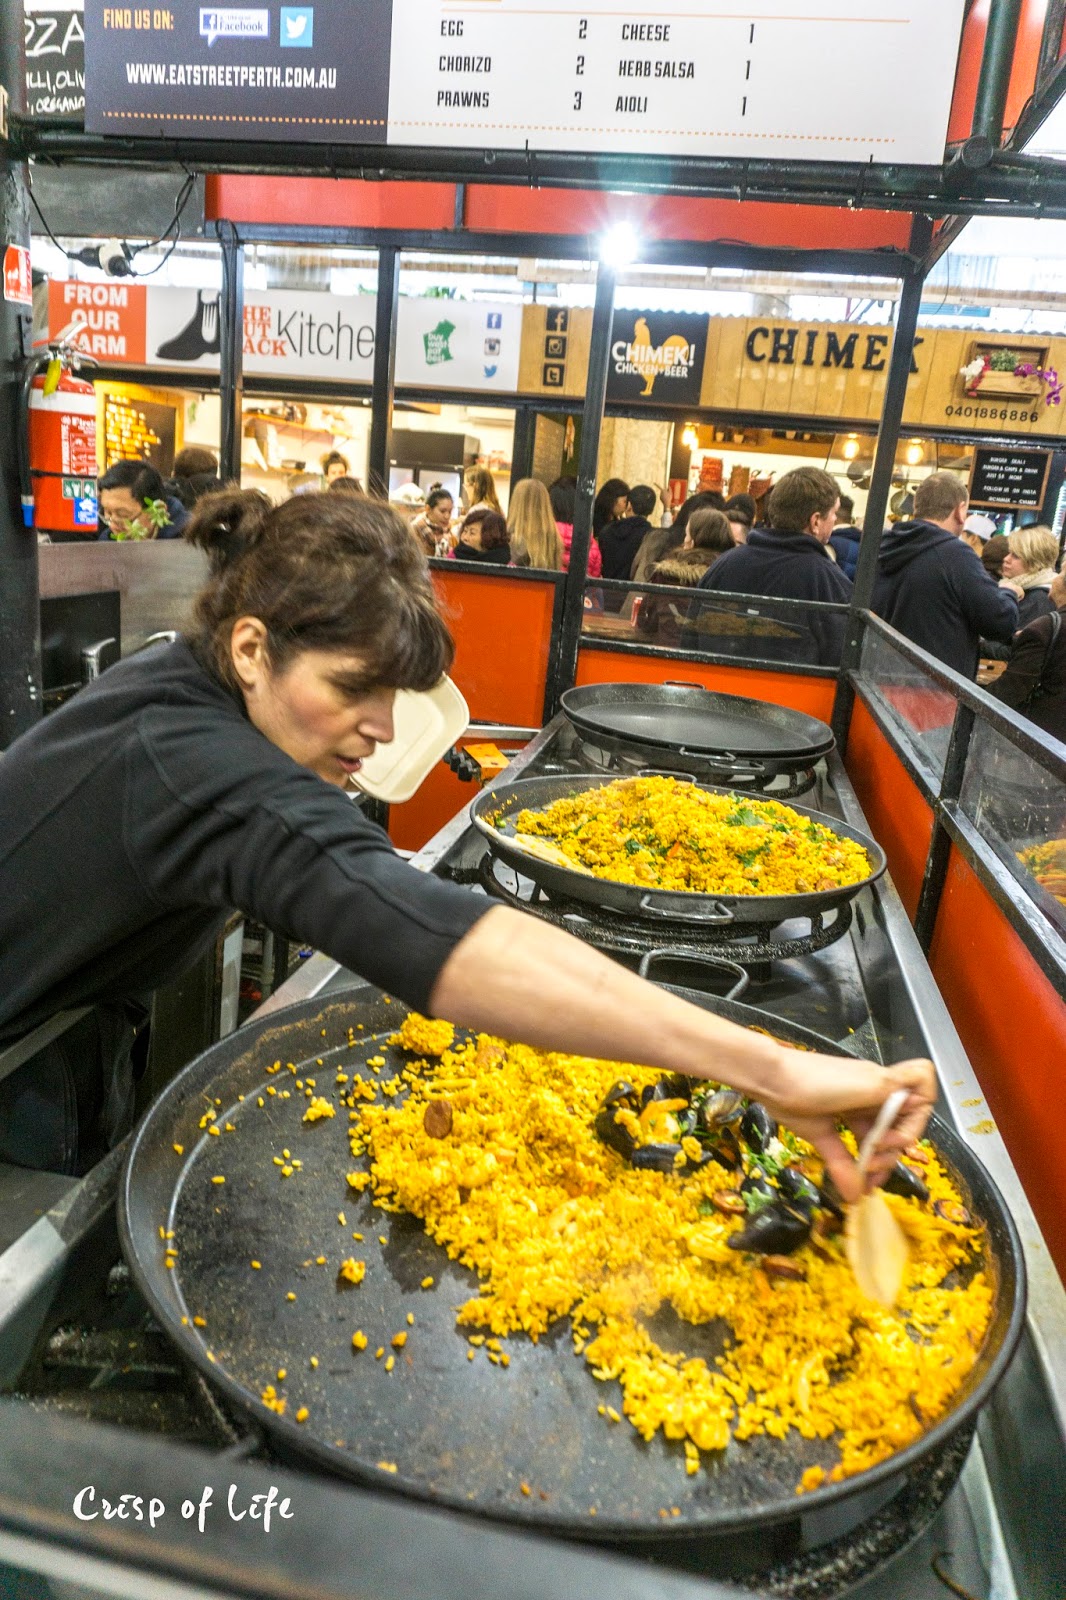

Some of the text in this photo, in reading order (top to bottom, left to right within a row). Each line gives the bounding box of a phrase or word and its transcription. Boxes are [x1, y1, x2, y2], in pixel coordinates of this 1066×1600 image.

[103, 8, 174, 31] FIND US ON:
[219, 20, 264, 32] Facebook
[440, 19, 588, 40] EGG 2
[621, 23, 755, 44] CHEESE 1
[126, 63, 337, 89] WWW.EATSTREETPERTH.COM.AU
[438, 55, 585, 76] CHORIZO 2
[618, 60, 751, 80] HERB SALSA 1
[436, 90, 582, 111] PRAWNS 3
[615, 96, 747, 116] AIOLI 1
[63, 284, 128, 307] FROM
[71, 308, 120, 331] OUR
[242, 305, 271, 321] HE
[243, 320, 271, 338] UT
[277, 309, 375, 361] Kitche
[73, 334, 127, 356] ARM
[242, 337, 287, 357] ACK
[611, 340, 696, 367] CHIMEK!
[945, 405, 1038, 422] 0401886886
